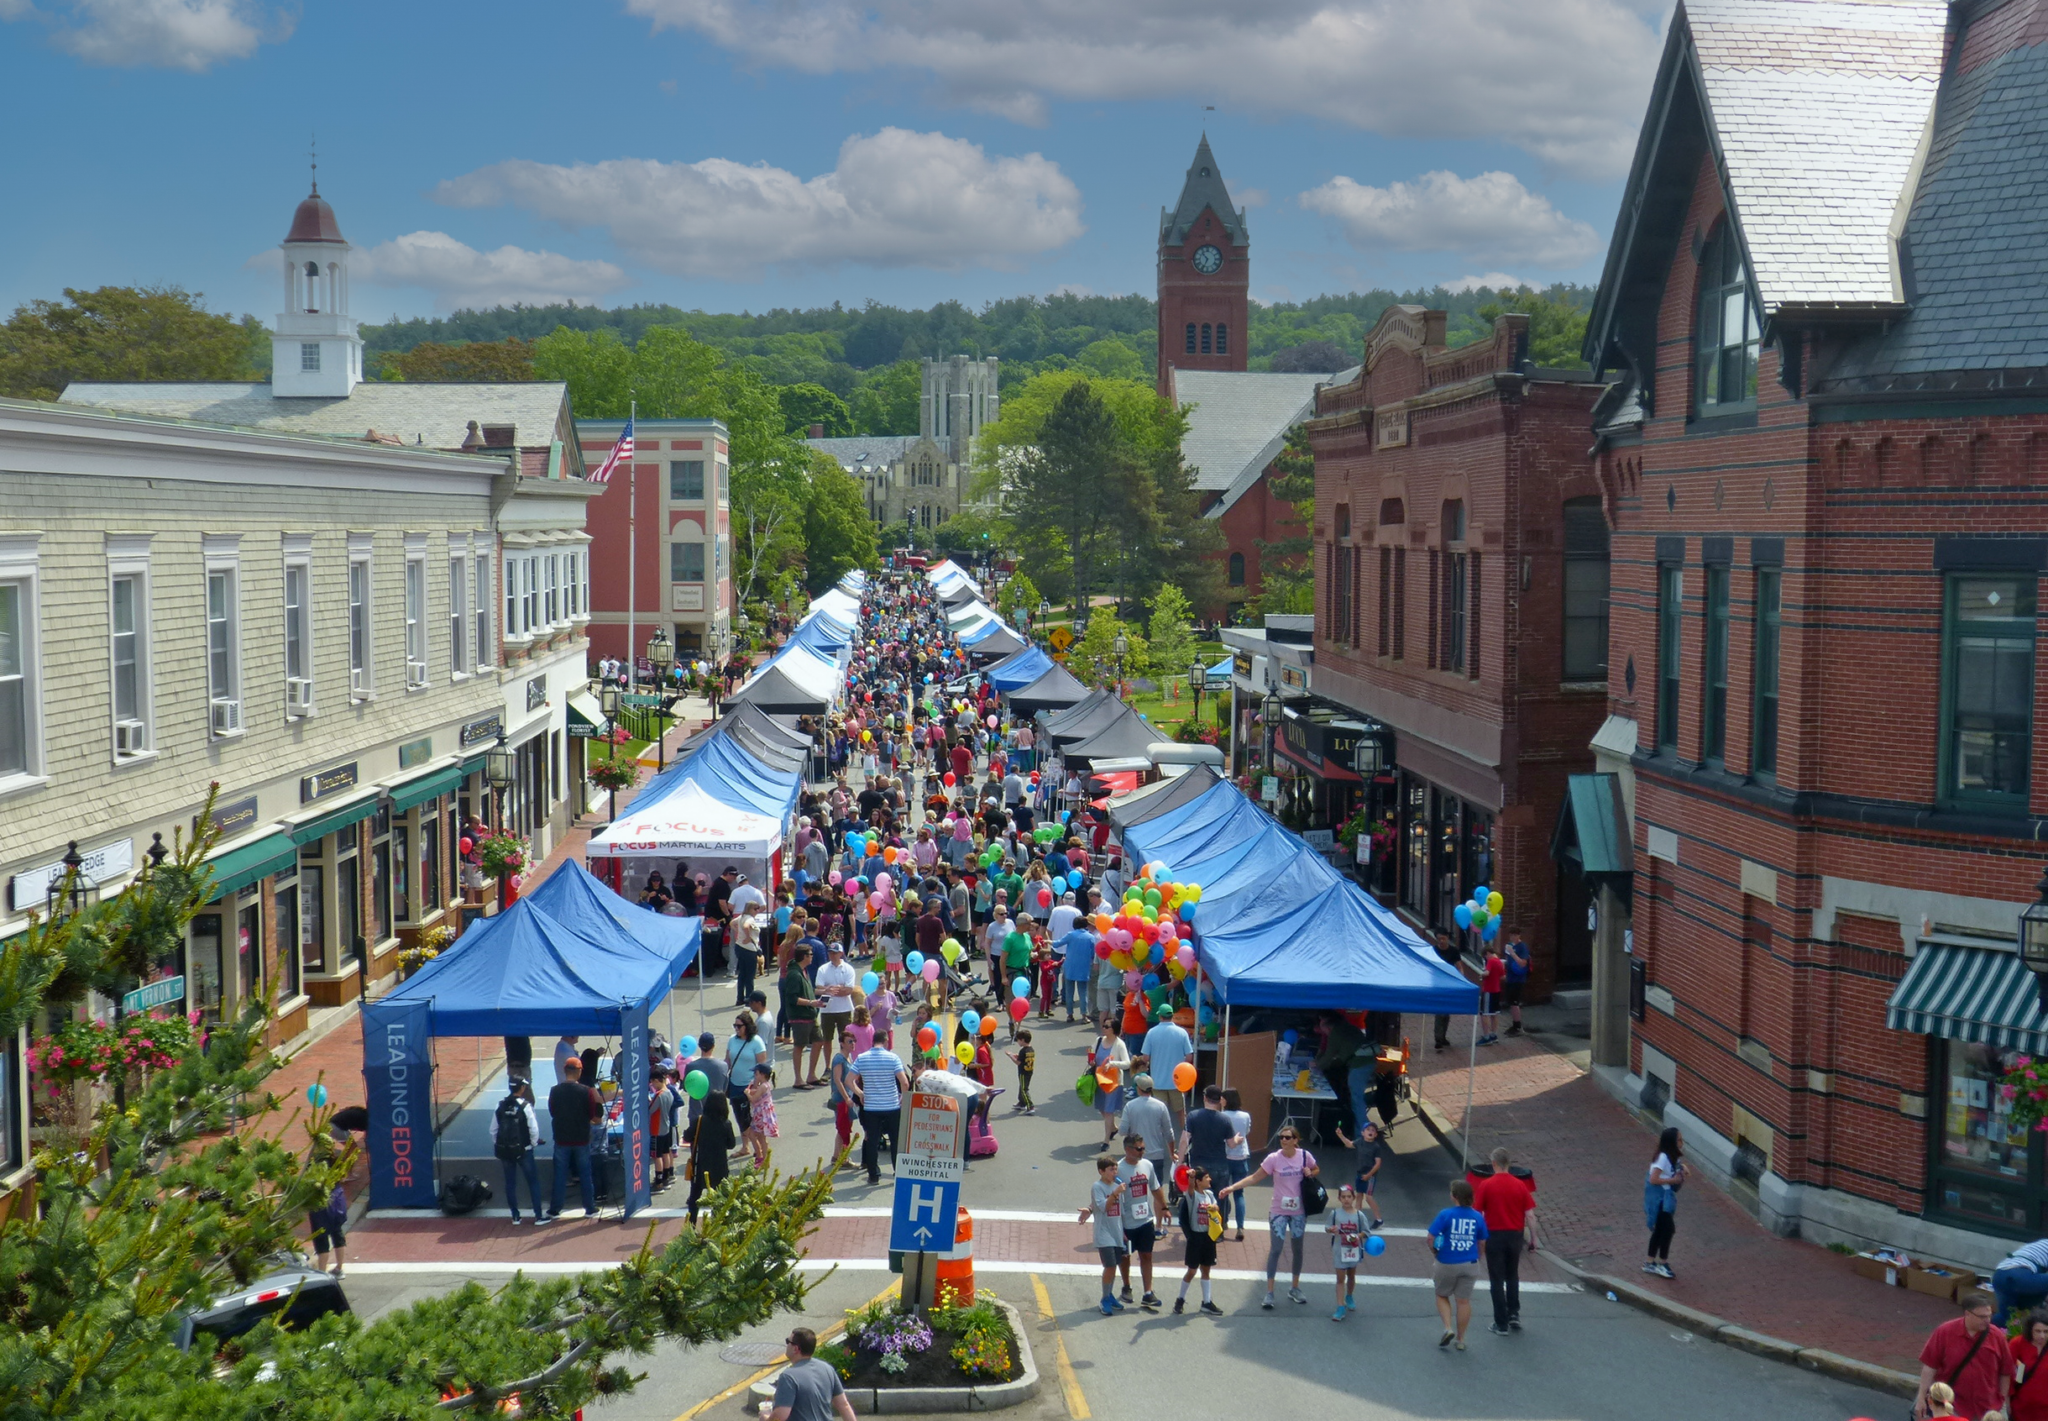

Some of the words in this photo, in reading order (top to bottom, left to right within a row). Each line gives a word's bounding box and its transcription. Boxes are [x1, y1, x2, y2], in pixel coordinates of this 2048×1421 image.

[635, 822, 725, 836] FOCUS
[609, 842, 657, 854] FOCUS
[659, 841, 712, 849] MARTIAL
[714, 842, 746, 850] ARTS
[84, 852, 105, 871] EDGE
[141, 983, 171, 1008] VERNON
[921, 1095, 950, 1110] STOP
[928, 1113, 941, 1121] FOR
[914, 1122, 953, 1132] PEDESTRIANS
[914, 1140, 950, 1151] CROSSWALK
[902, 1158, 958, 1169] WINCHESTER
[908, 1169, 949, 1179] HOSPITAL
[908, 1183, 944, 1223] H
[1451, 1218, 1477, 1234] LIFE
[1450, 1239, 1474, 1251] TOP
